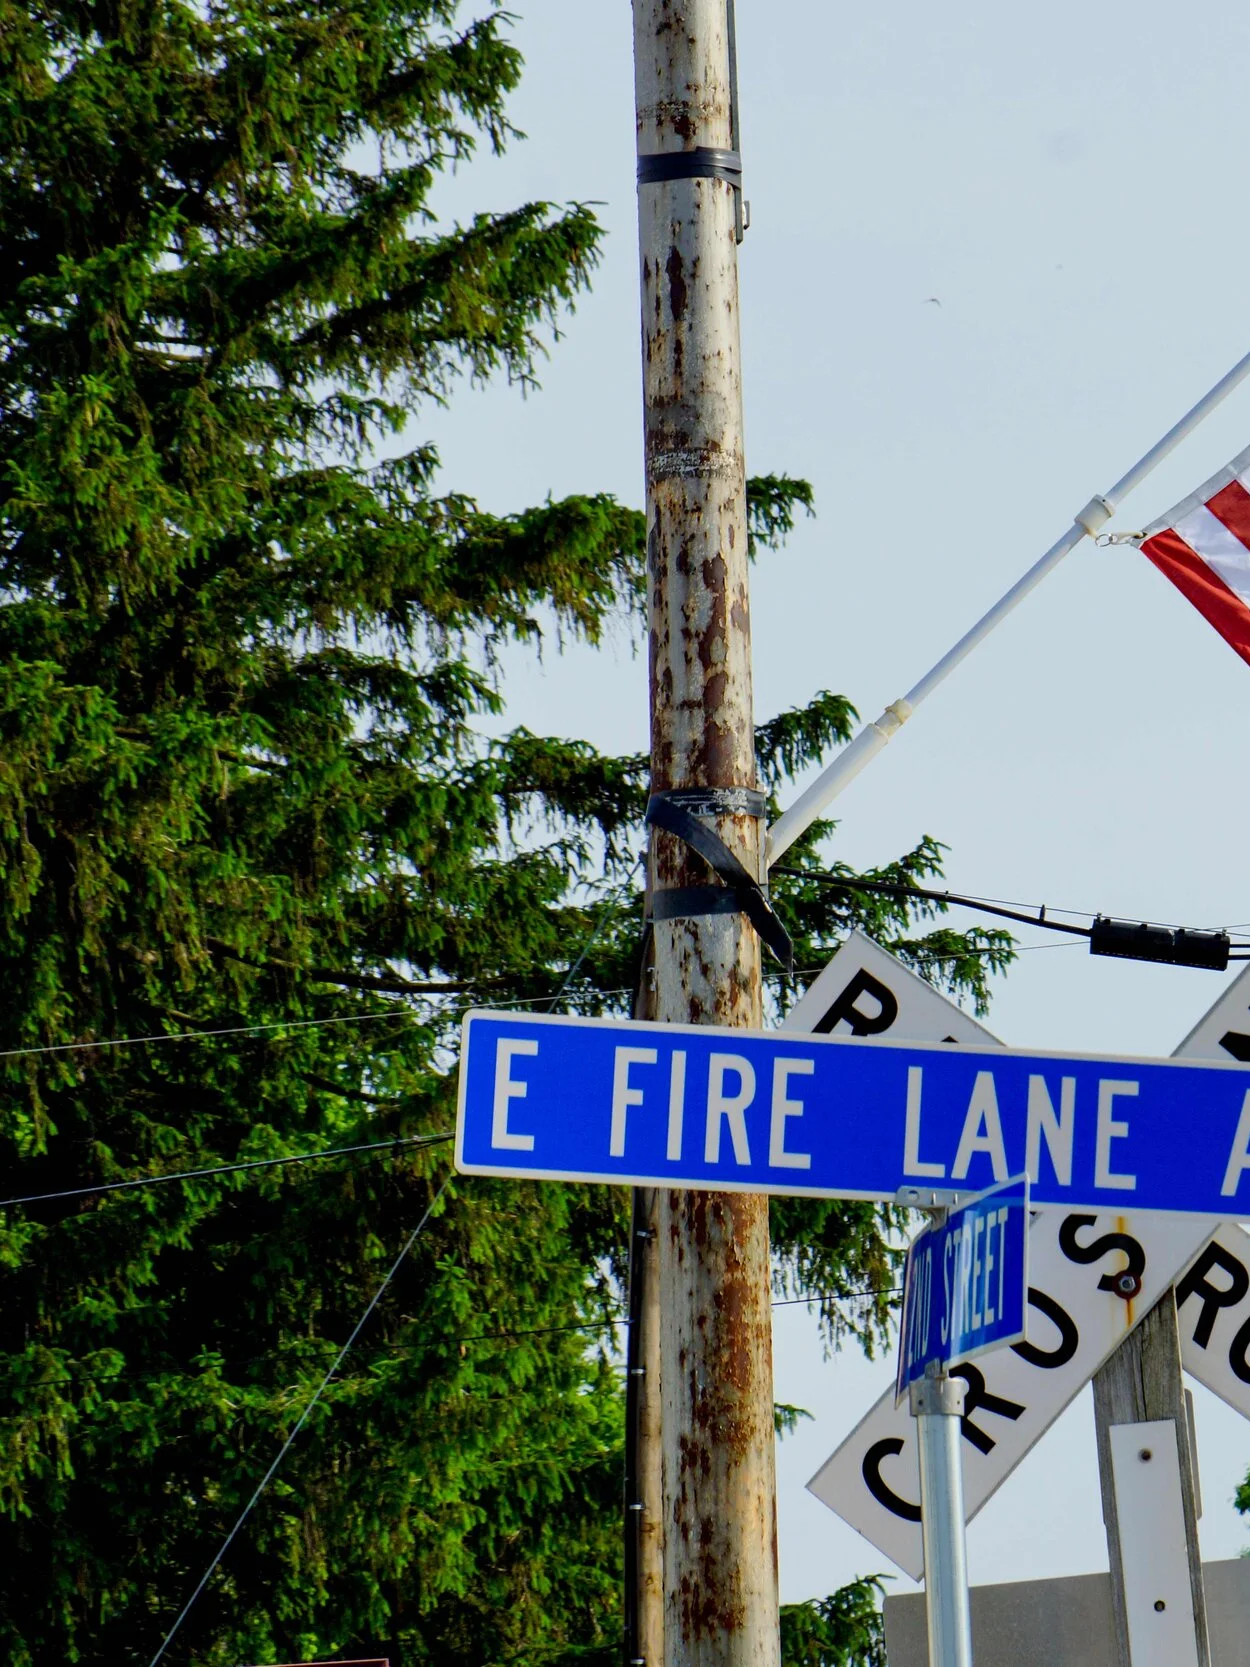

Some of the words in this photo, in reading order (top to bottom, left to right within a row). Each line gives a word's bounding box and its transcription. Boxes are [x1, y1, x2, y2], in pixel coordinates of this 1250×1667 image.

[491, 1037, 539, 1151] E
[609, 1045, 815, 1170] FIRE
[903, 1066, 1140, 1190] LANE
[908, 1247, 932, 1368] 2ND
[941, 1206, 1008, 1346] STREET
